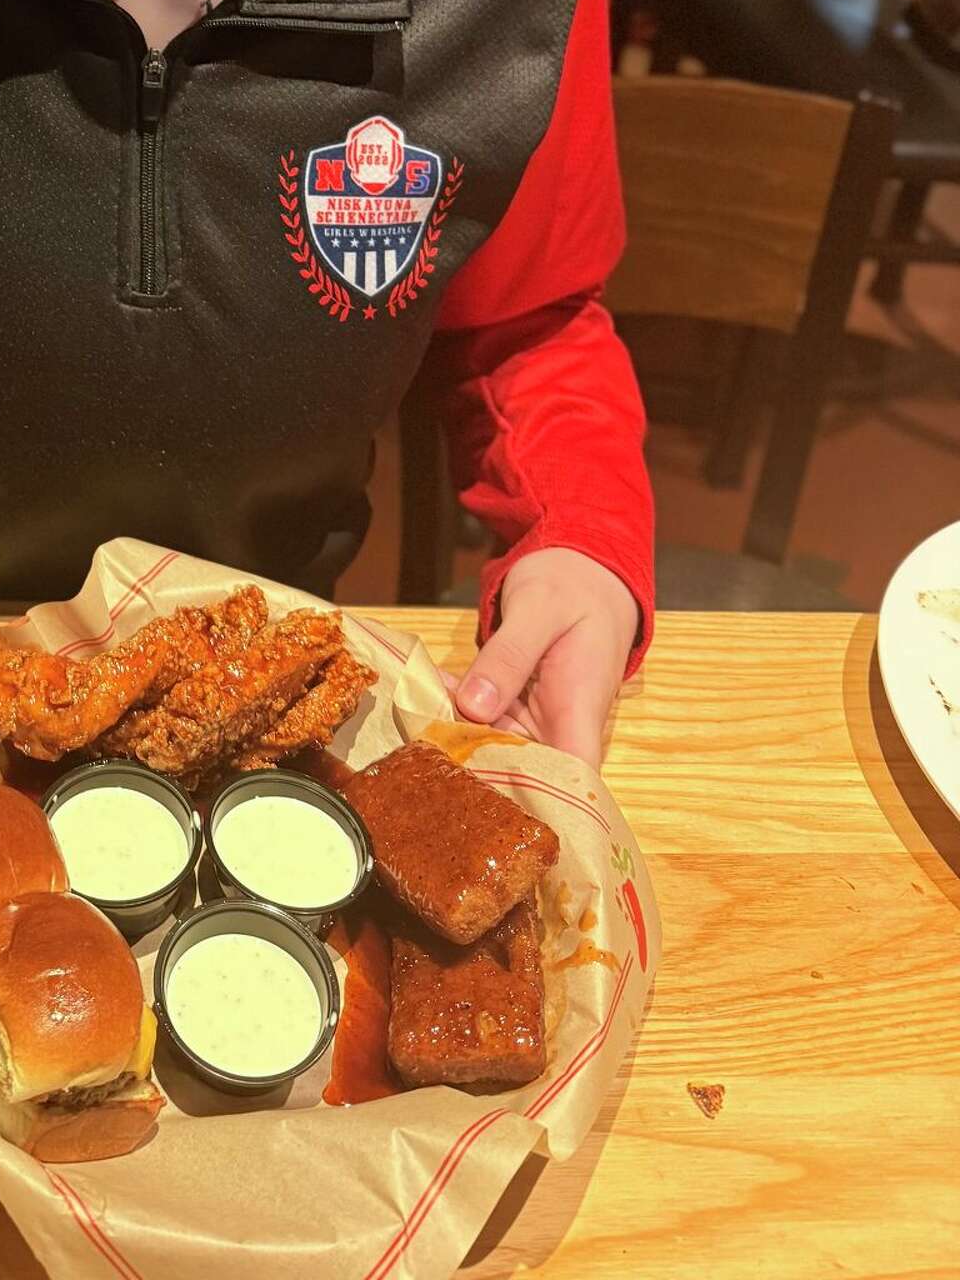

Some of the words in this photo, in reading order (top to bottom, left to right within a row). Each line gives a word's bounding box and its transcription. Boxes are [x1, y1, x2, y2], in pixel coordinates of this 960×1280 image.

[361, 144, 388, 155] EST.
[315, 159, 345, 192] N
[405, 160, 431, 195] S
[327, 198, 412, 211] NISKAYUNA
[315, 210, 419, 225] SCHENECTADY
[324, 227, 355, 238] GIRLS
[359, 225, 412, 238] WRESTLING
